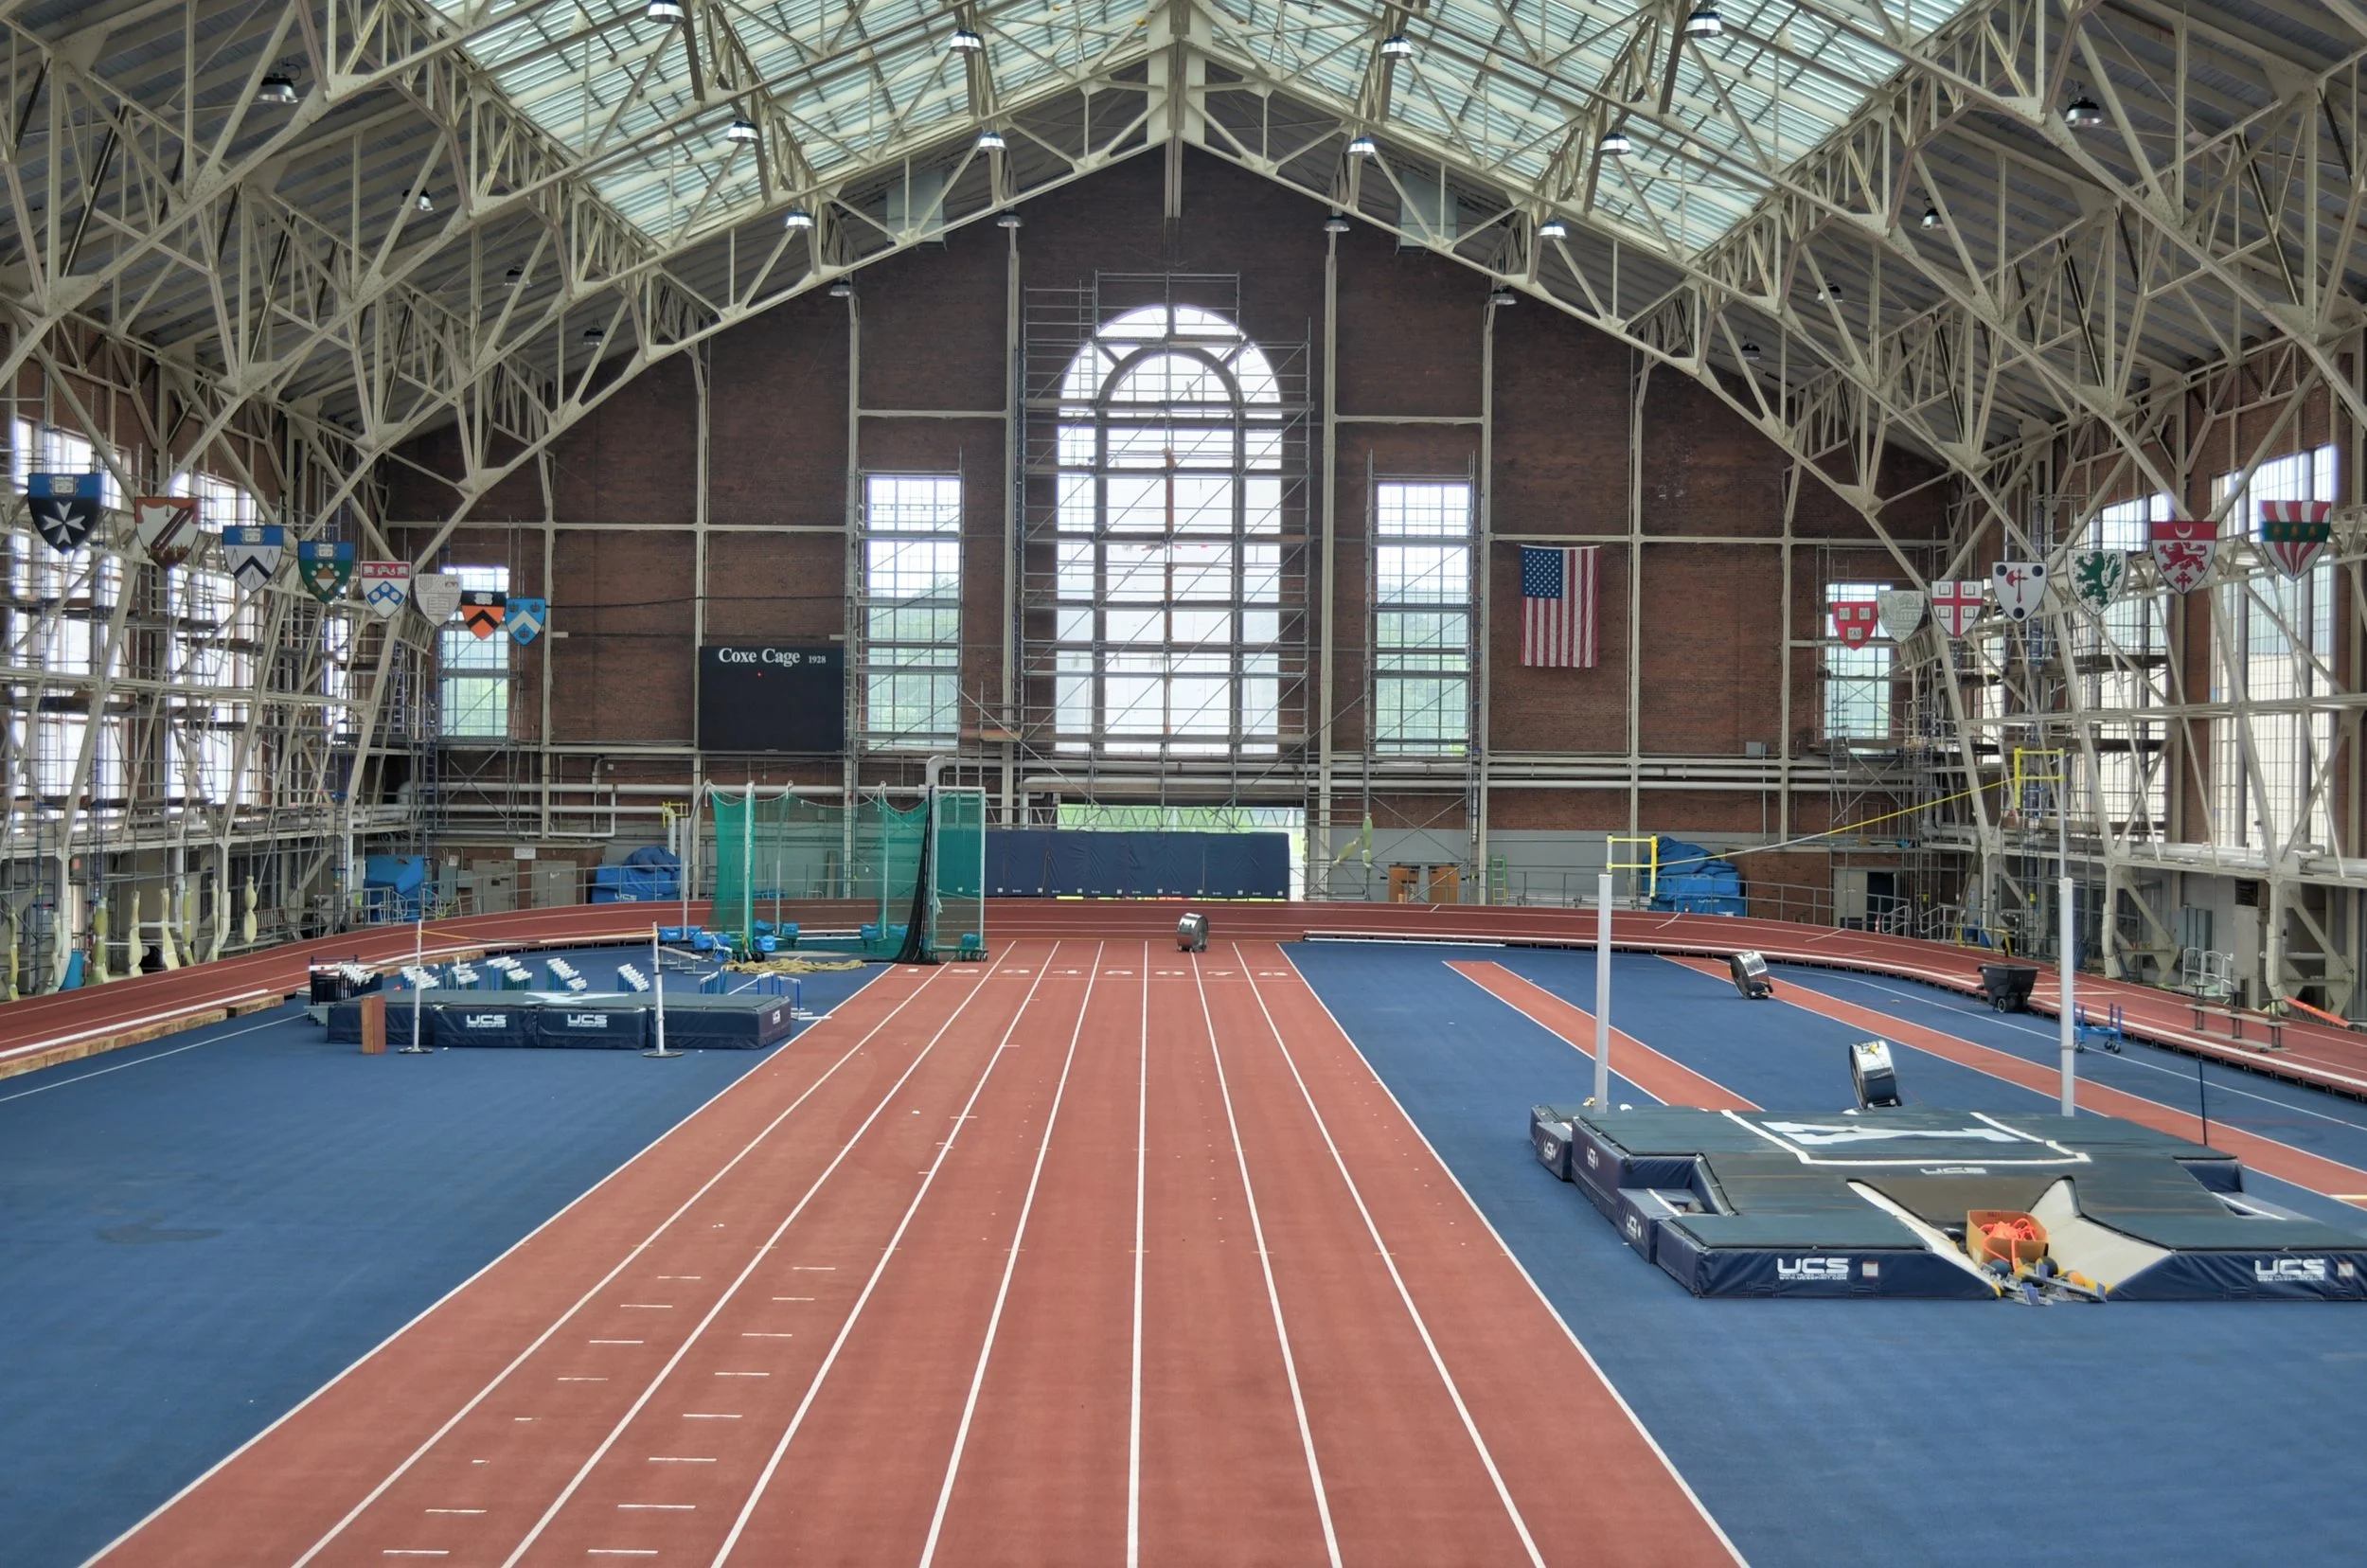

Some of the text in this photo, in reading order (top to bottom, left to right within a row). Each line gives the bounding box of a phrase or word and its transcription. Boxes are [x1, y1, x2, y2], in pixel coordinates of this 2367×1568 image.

[719, 648, 827, 668] Coxe Cage 1928
[466, 1014, 507, 1024] UCS
[567, 1014, 607, 1024] UCS
[1777, 1257, 1849, 1274] UCS
[2254, 1259, 2325, 1274] UCS
